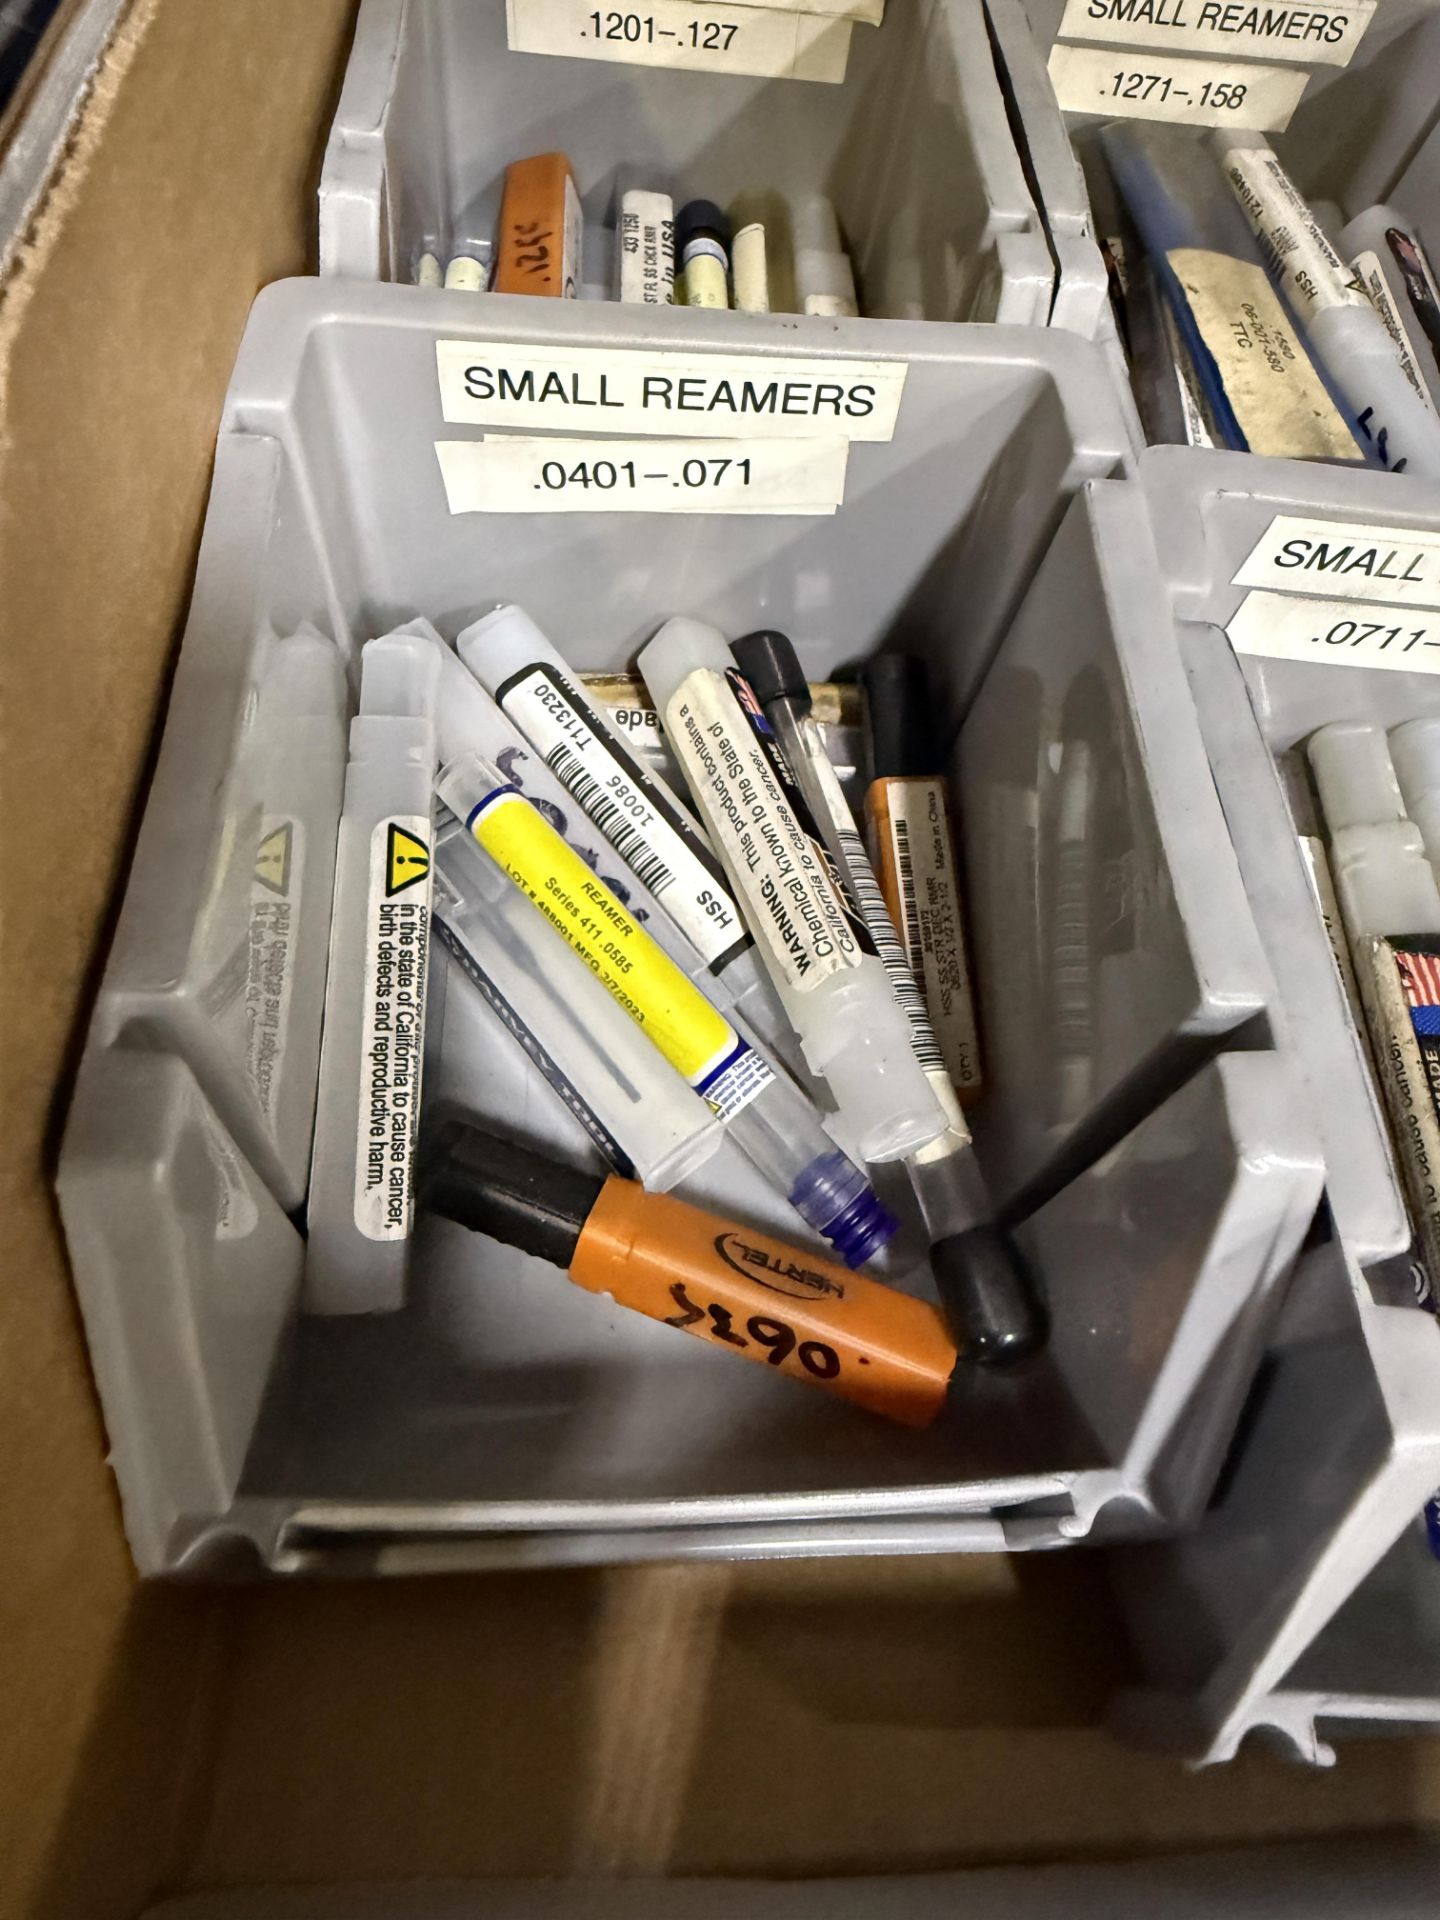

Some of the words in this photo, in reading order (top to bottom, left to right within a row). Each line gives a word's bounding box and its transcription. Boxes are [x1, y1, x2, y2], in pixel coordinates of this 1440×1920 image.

[1087, 0, 1187, 28] SMALL
[1197, 2, 1350, 43] REAMERS
[1294, 269, 1319, 301] HSS
[463, 365, 625, 407] SMALL
[642, 376, 877, 417] REAMERS
[1273, 539, 1425, 582] SMALL
[531, 681, 594, 752] T113230
[615, 709, 658, 728] ade
[679, 703, 689, 718] a
[708, 721, 725, 738] of
[684, 717, 722, 782] contains
[717, 736, 747, 781] State
[604, 772, 655, 828] 10086
[713, 774, 748, 838] product
[738, 777, 761, 805] the
[751, 801, 769, 821] to
[922, 789, 941, 822] China
[759, 816, 799, 879] known
[775, 805, 806, 852] cause
[739, 830, 765, 874] This
[800, 854, 814, 872] to
[929, 837, 947, 870] Made
[380, 903, 398, 937] birth
[400, 903, 415, 923] in
[542, 874, 585, 920] Series
[577, 913, 604, 942] 411
[597, 936, 635, 977] .0585
[580, 878, 634, 940] REAMER
[695, 890, 734, 931] HSS
[759, 872, 811, 977] WARNING:
[784, 870, 835, 958] Chemical
[809, 873, 855, 954] California
[399, 923, 415, 949] the
[376, 940, 396, 1001] defects
[398, 949, 415, 985] state
[375, 1001, 393, 1032] and
[398, 987, 415, 1011] of
[394, 1011, 415, 1088] California
[367, 1035, 392, 1138] reproductive
[394, 1089, 409, 1111] to
[390, 1111, 408, 1164] cause
[366, 1139, 385, 1192] harm,
[383, 1165, 405, 1230] cancer,
[732, 1239, 846, 1299] HERTEL
